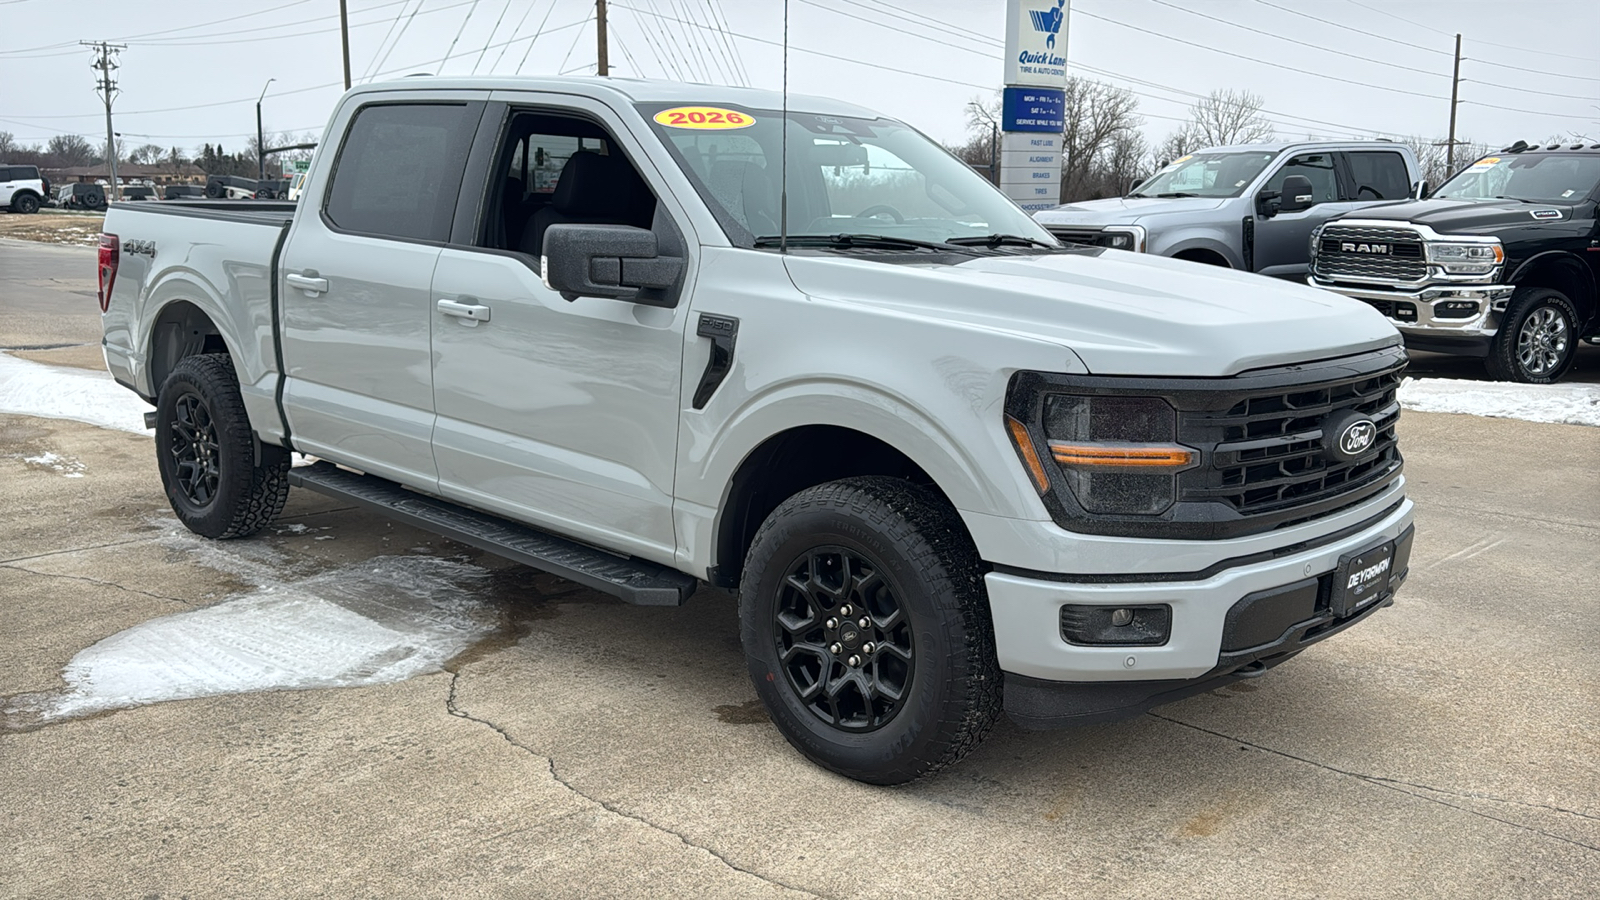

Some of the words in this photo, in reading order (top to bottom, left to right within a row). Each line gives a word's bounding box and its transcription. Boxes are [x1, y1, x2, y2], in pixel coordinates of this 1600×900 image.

[1019, 50, 1048, 64] Quick
[1048, 53, 1066, 66] Lane
[668, 112, 745, 124] 2026
[1341, 242, 1387, 253] RAM
[1346, 425, 1371, 450] Ford
[831, 519, 886, 553] TERRITORY
